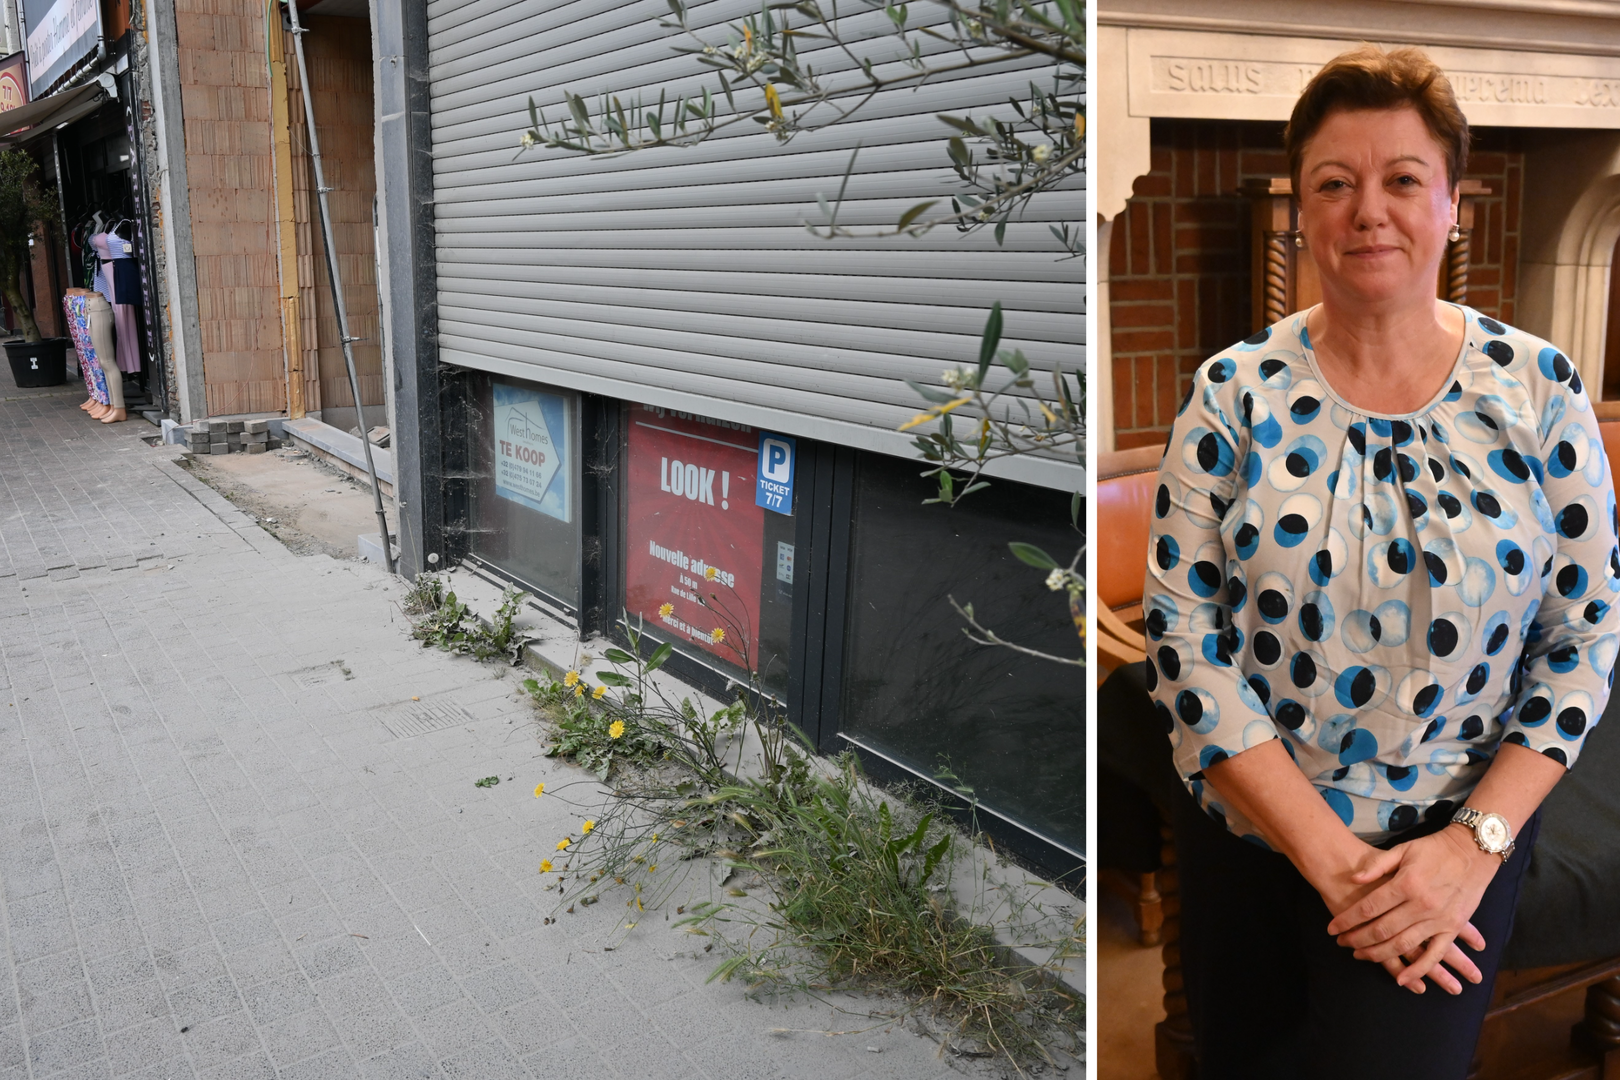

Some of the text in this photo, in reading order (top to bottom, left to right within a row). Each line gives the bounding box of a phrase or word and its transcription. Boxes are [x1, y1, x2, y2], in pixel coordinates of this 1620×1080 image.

[500, 439, 546, 467] TE KOOP
[661, 456, 730, 511] LOOK !
[760, 479, 790, 496] TICKET
[766, 491, 783, 508] 7/7
[649, 539, 735, 588] Nouvelle adrsse
[684, 576, 692, 587] 50
[692, 580, 698, 590] m
[671, 585, 680, 596] Rue
[680, 589, 686, 599] de
[686, 592, 697, 603] Lille
[679, 621, 686, 633] et
